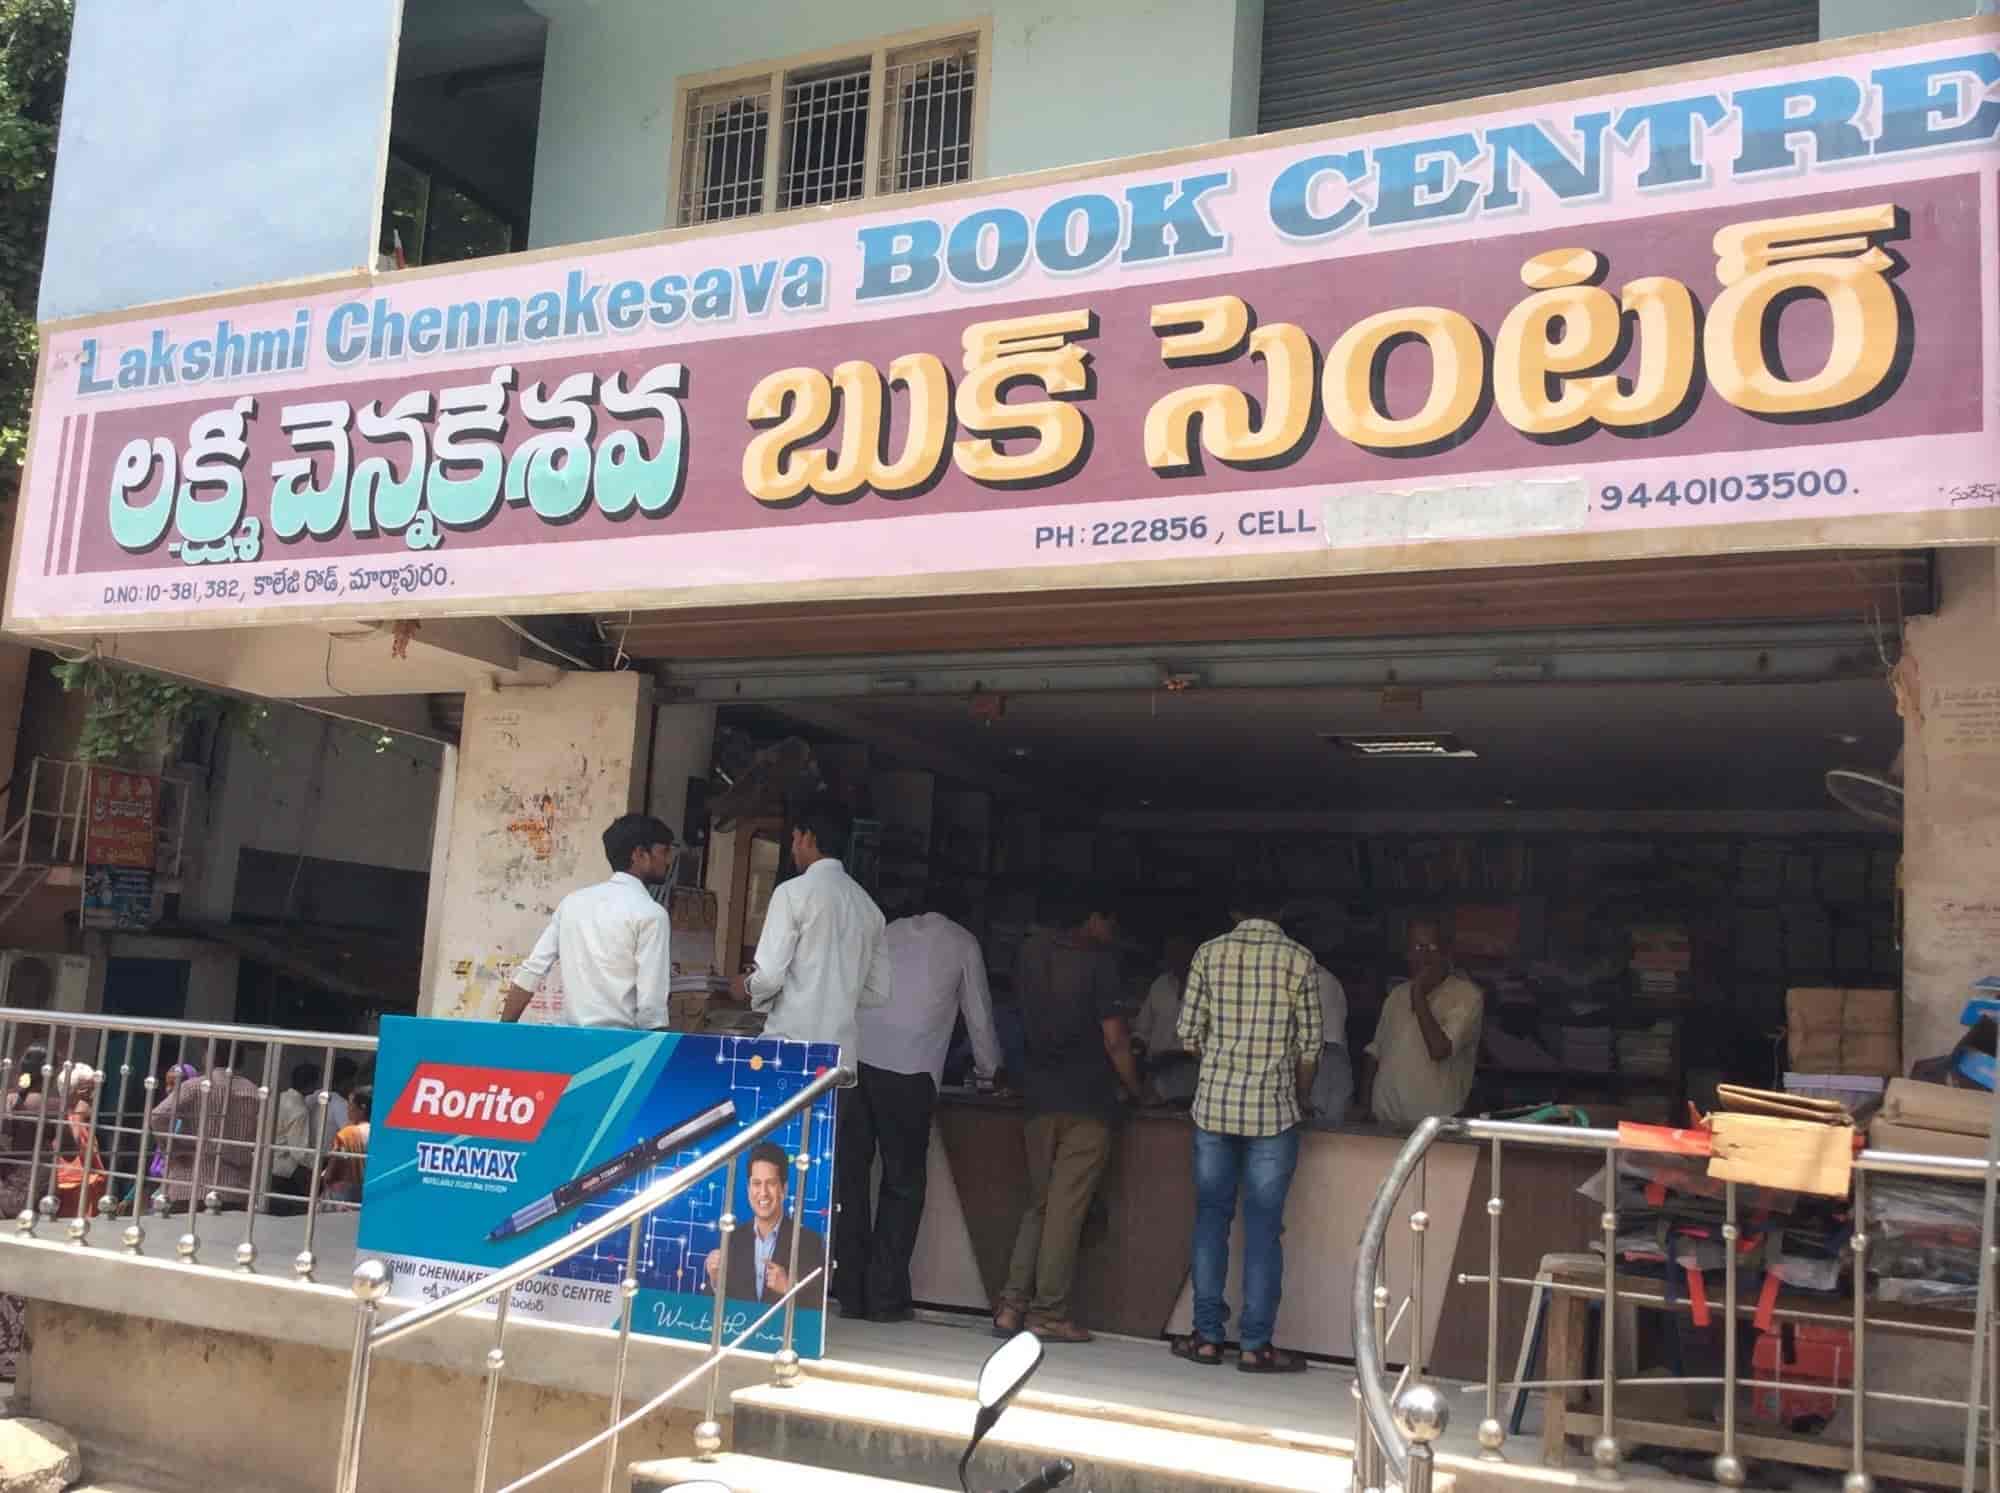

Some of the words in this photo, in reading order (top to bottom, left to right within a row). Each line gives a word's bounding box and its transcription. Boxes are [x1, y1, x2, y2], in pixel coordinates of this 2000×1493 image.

[76, 309, 311, 394] Lakshmi
[325, 254, 829, 363] Chennakesava
[856, 169, 1232, 301] BOOK
[1268, 50, 2000, 239] CENTRE
[109, 396, 263, 565] లక్ష్మీ
[270, 362, 688, 551] చెన్నకేశవ
[741, 308, 1099, 508] బుక్
[1144, 202, 1913, 478] సెంటర్
[1237, 508, 1317, 537] CELL
[411, 1077, 536, 1125] Rorito
[418, 1143, 519, 1182] TERAMAX
[515, 1278, 559, 1298] BOOKS
[562, 1284, 613, 1305] CENTRE
